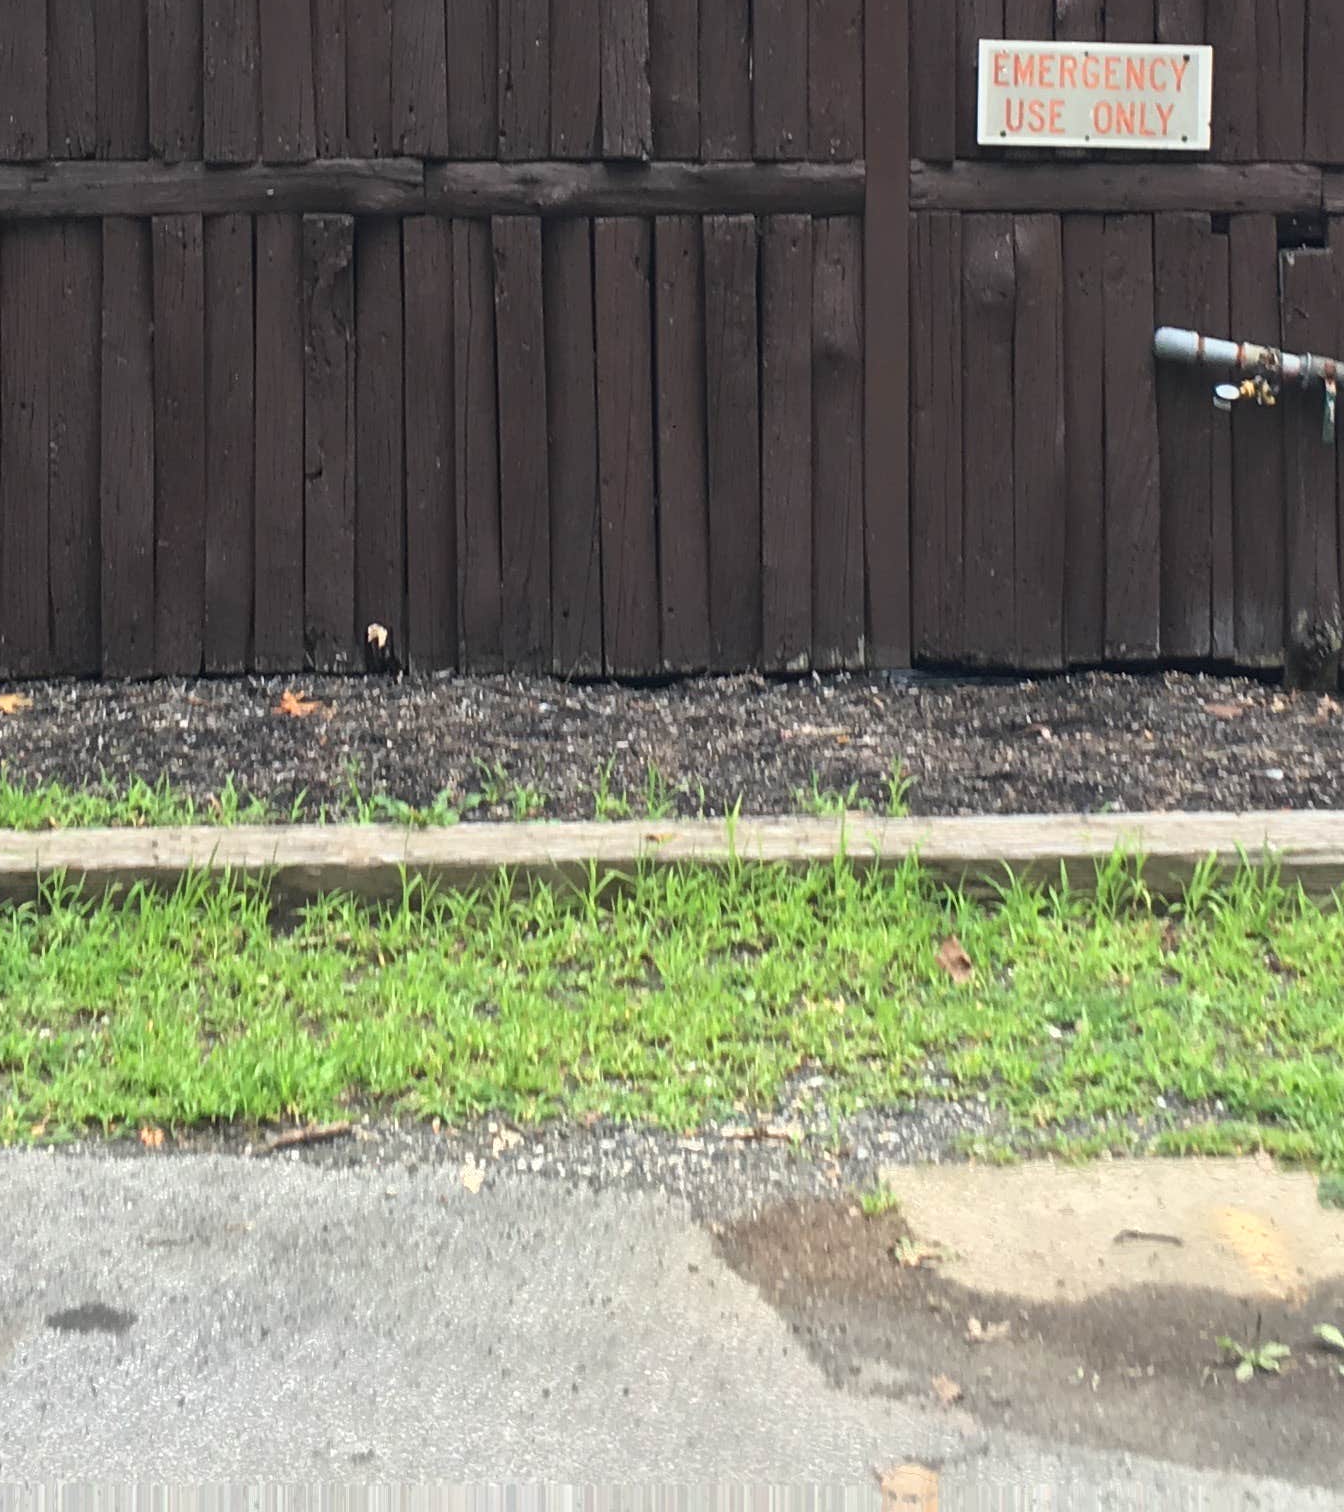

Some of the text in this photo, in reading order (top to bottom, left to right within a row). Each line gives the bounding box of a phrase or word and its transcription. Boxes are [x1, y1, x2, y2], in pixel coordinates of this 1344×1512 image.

[993, 52, 1189, 93] EMERGENCY
[1006, 98, 1174, 137] USE ONLY
